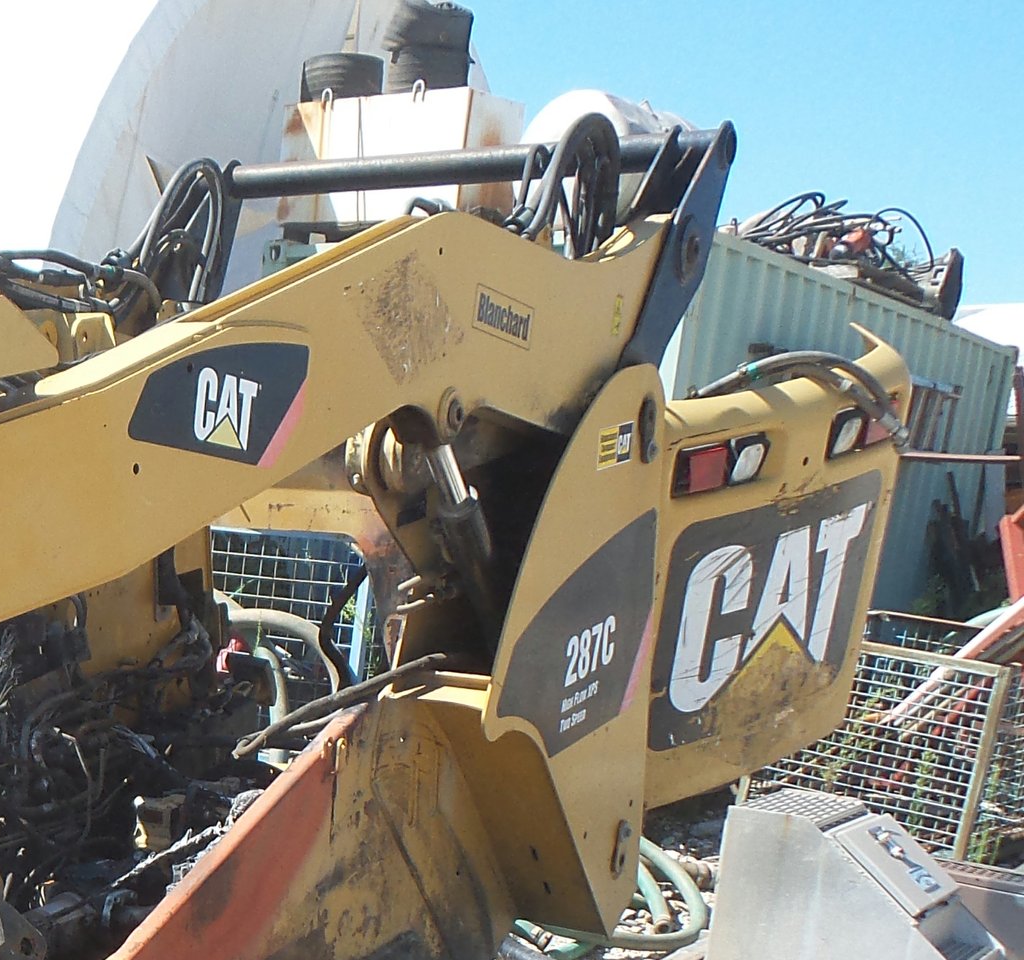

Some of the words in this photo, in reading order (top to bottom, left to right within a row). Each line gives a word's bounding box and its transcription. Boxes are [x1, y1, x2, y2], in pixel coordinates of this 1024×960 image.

[477, 292, 530, 341] Blanchard
[193, 366, 262, 451] CAT
[617, 433, 632, 454] CAT
[669, 500, 872, 713] CAT
[564, 615, 616, 688] 287C
